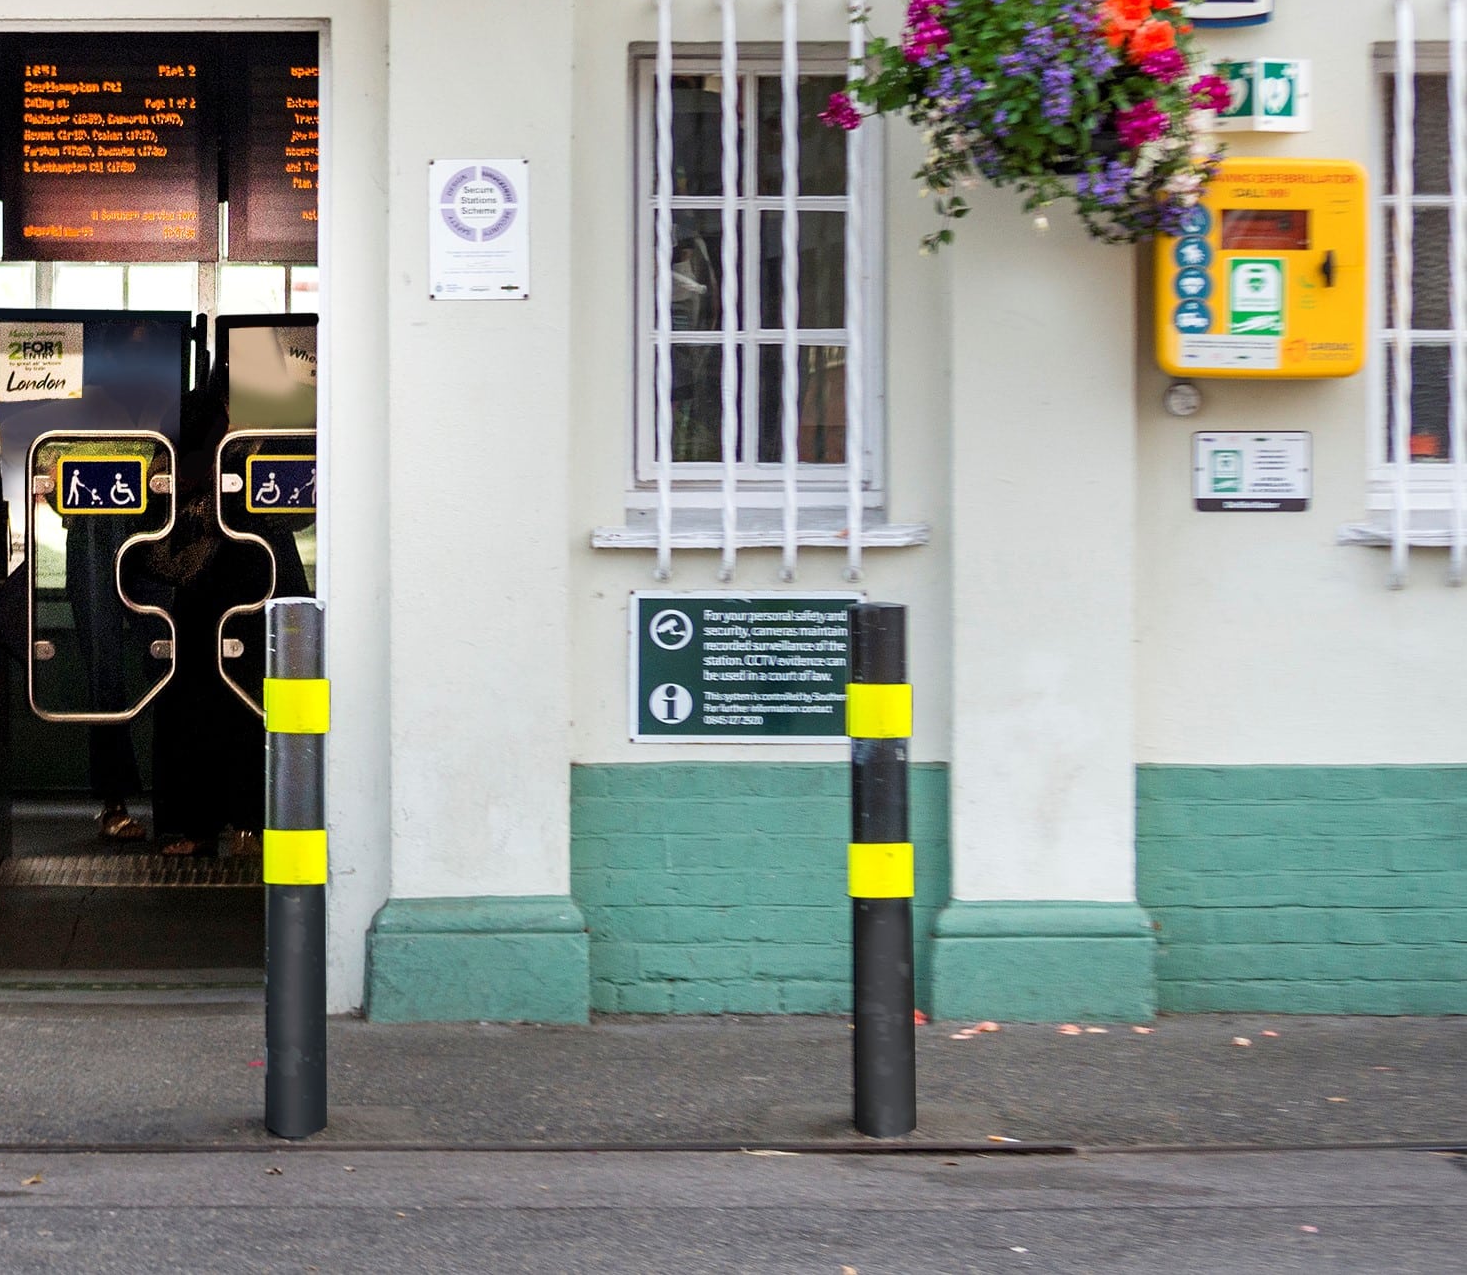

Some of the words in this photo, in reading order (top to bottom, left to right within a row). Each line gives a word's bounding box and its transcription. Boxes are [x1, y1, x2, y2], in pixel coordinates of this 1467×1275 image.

[6, 370, 66, 393] London
[703, 610, 721, 621] For
[721, 612, 747, 623] your
[747, 610, 794, 623] personal
[794, 610, 824, 624] safety
[825, 610, 848, 621] and
[751, 627, 799, 636] cameras
[799, 626, 848, 636] maintain
[703, 640, 751, 651] recorded
[752, 640, 814, 651] surveillance
[814, 640, 829, 651] of
[829, 640, 847, 651] the
[744, 655, 777, 666] CCTV
[777, 655, 825, 666] evidence
[825, 657, 847, 666] can
[703, 670, 719, 681] be
[719, 670, 745, 681] used
[746, 670, 758, 681] in
[767, 671, 797, 681] court
[797, 670, 812, 681] of
[812, 692, 849, 701] Souther
